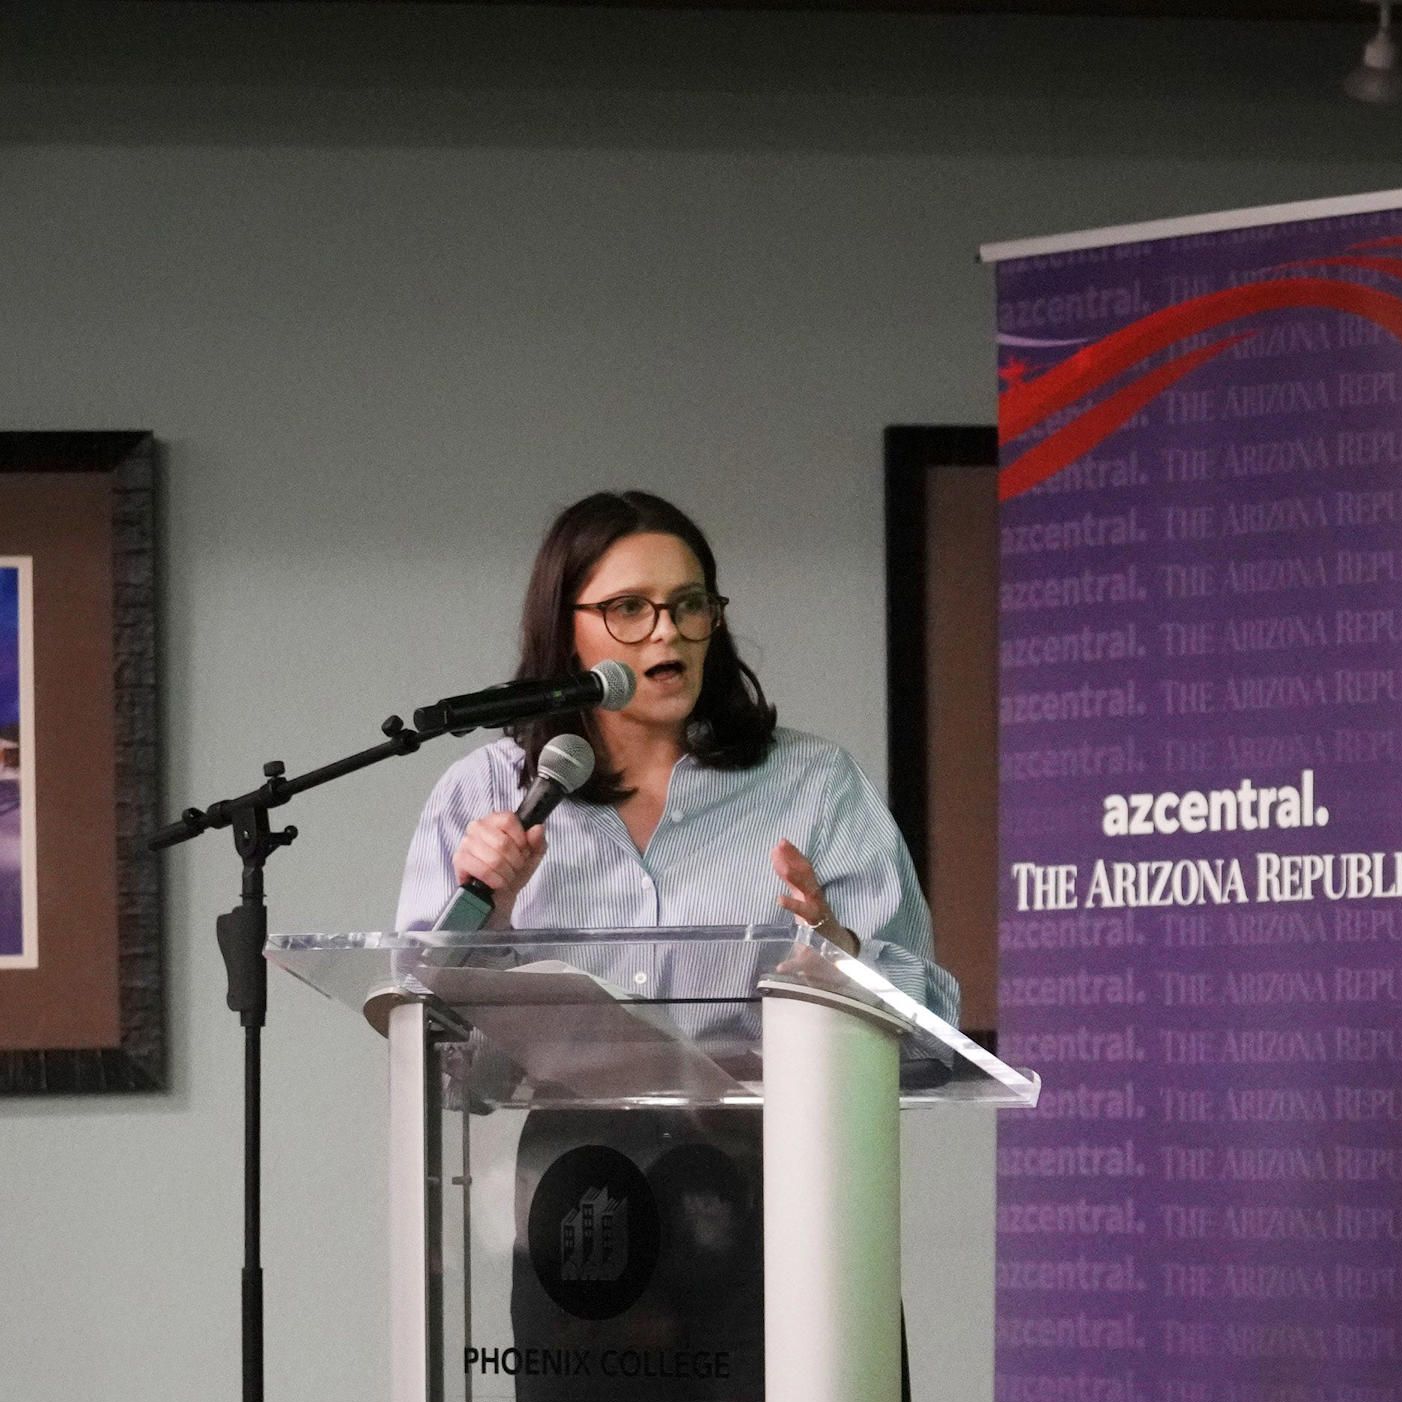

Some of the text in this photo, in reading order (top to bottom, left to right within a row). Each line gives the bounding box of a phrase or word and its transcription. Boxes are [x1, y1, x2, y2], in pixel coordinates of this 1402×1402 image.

[1103, 769, 1330, 836] azcentral.
[1012, 863, 1077, 911] THE
[1085, 858, 1249, 909] ARIZONA
[464, 1347, 730, 1379] PHOENIX COLLEGE
